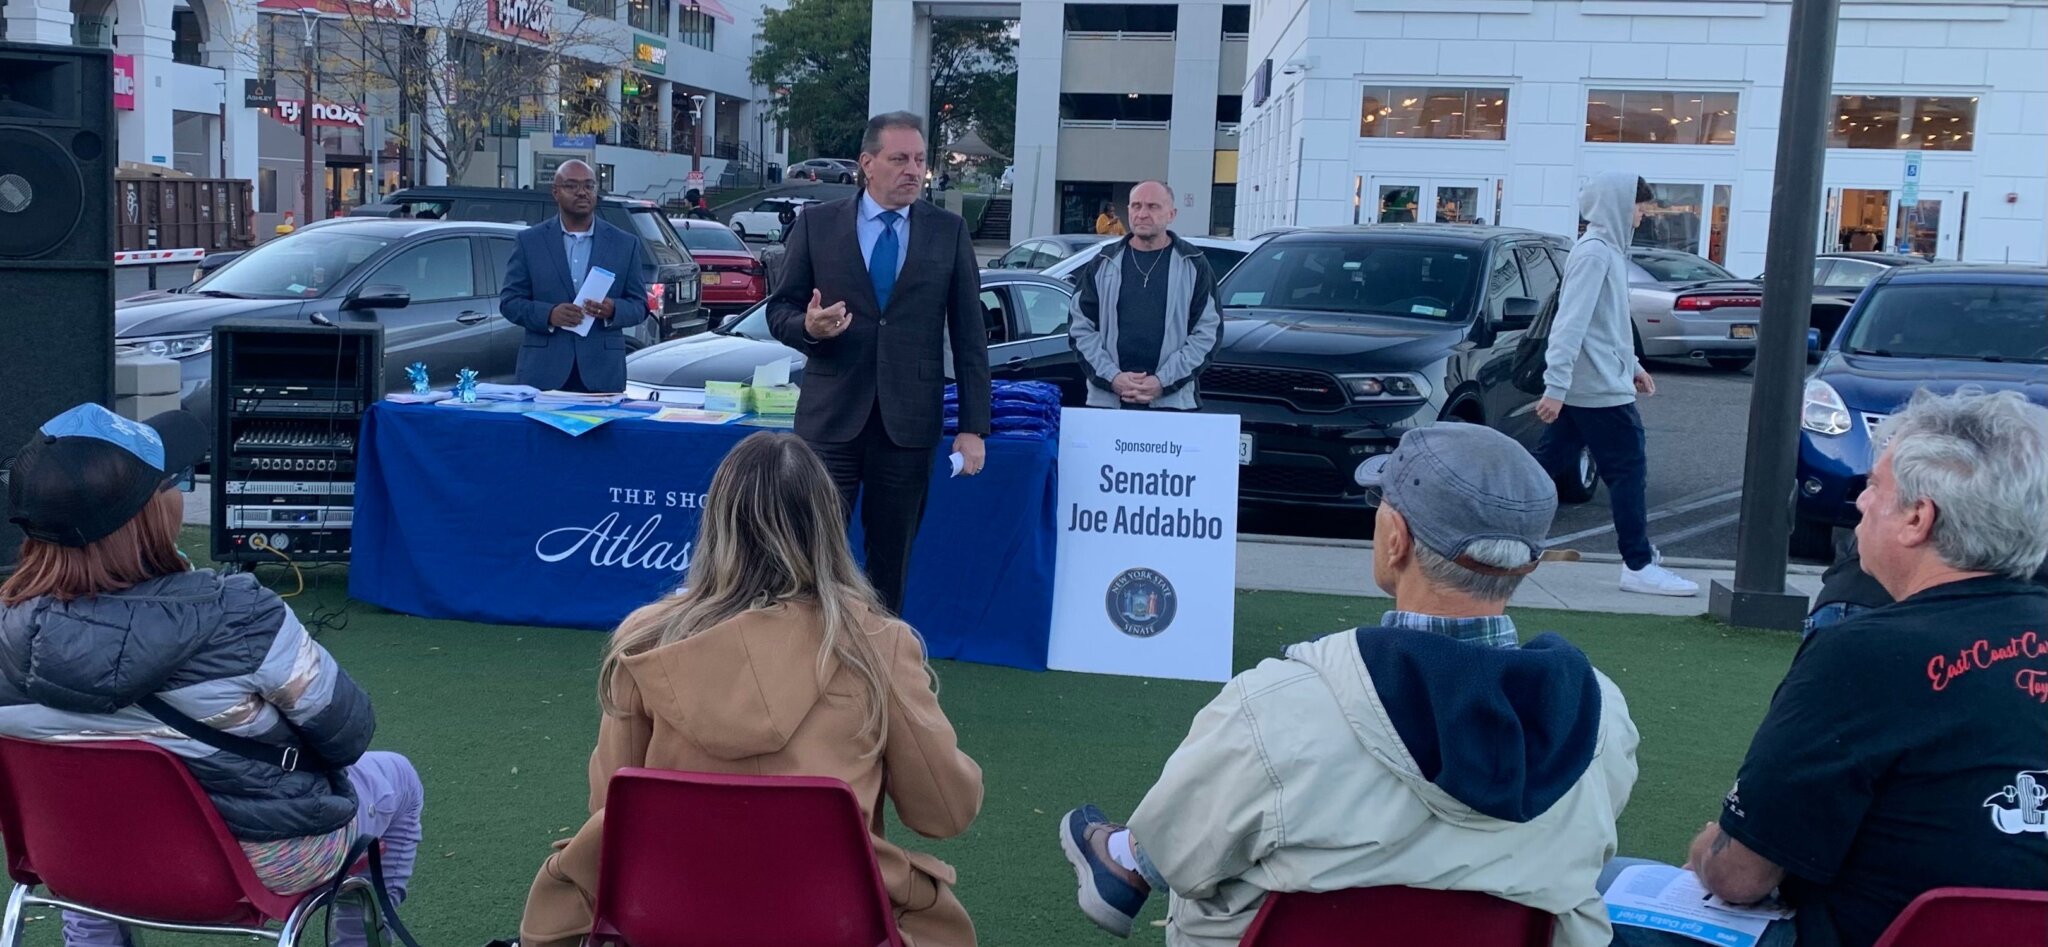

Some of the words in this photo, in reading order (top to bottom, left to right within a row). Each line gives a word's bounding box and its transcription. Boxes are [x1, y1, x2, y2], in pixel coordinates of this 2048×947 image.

[1114, 438, 1168, 454] Sponsored
[1169, 441, 1182, 457] by
[1099, 464, 1197, 498] Senator
[609, 487, 656, 506] THE
[1068, 503, 1108, 533] Joe
[1112, 505, 1223, 540] Addabbo
[535, 511, 693, 571] Atlas
[1111, 575, 1127, 594] NEW
[1127, 570, 1153, 581] YORK
[1154, 575, 1172, 597] STATE
[1124, 623, 1155, 635] SENATE
[1927, 654, 1971, 691] East
[1972, 639, 2019, 669] Coast
[1616, 909, 1648, 923] Brief
[1650, 914, 1679, 928] Data
